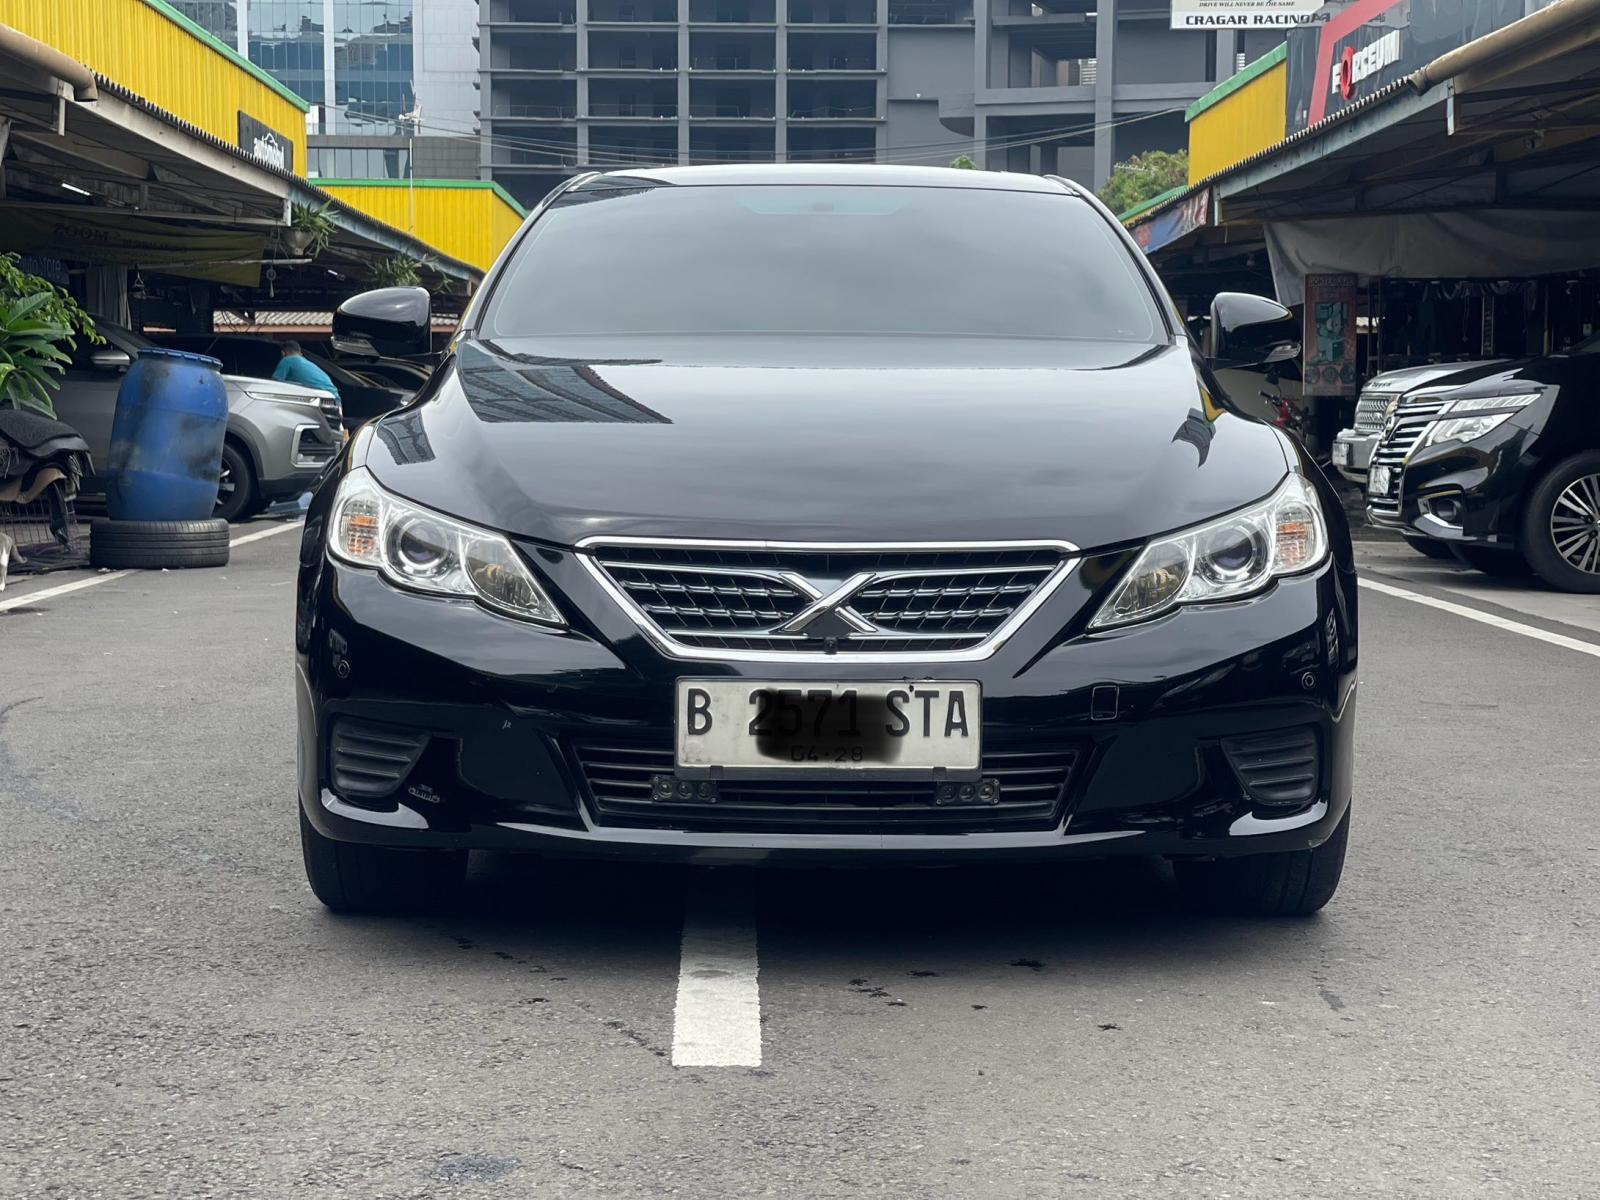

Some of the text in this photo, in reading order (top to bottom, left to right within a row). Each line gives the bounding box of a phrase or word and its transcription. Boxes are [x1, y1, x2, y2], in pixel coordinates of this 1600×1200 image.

[1185, 14, 1248, 25] CRAGAR
[1331, 29, 1400, 101] FORCEUM
[687, 688, 969, 738] B 2571 STA
